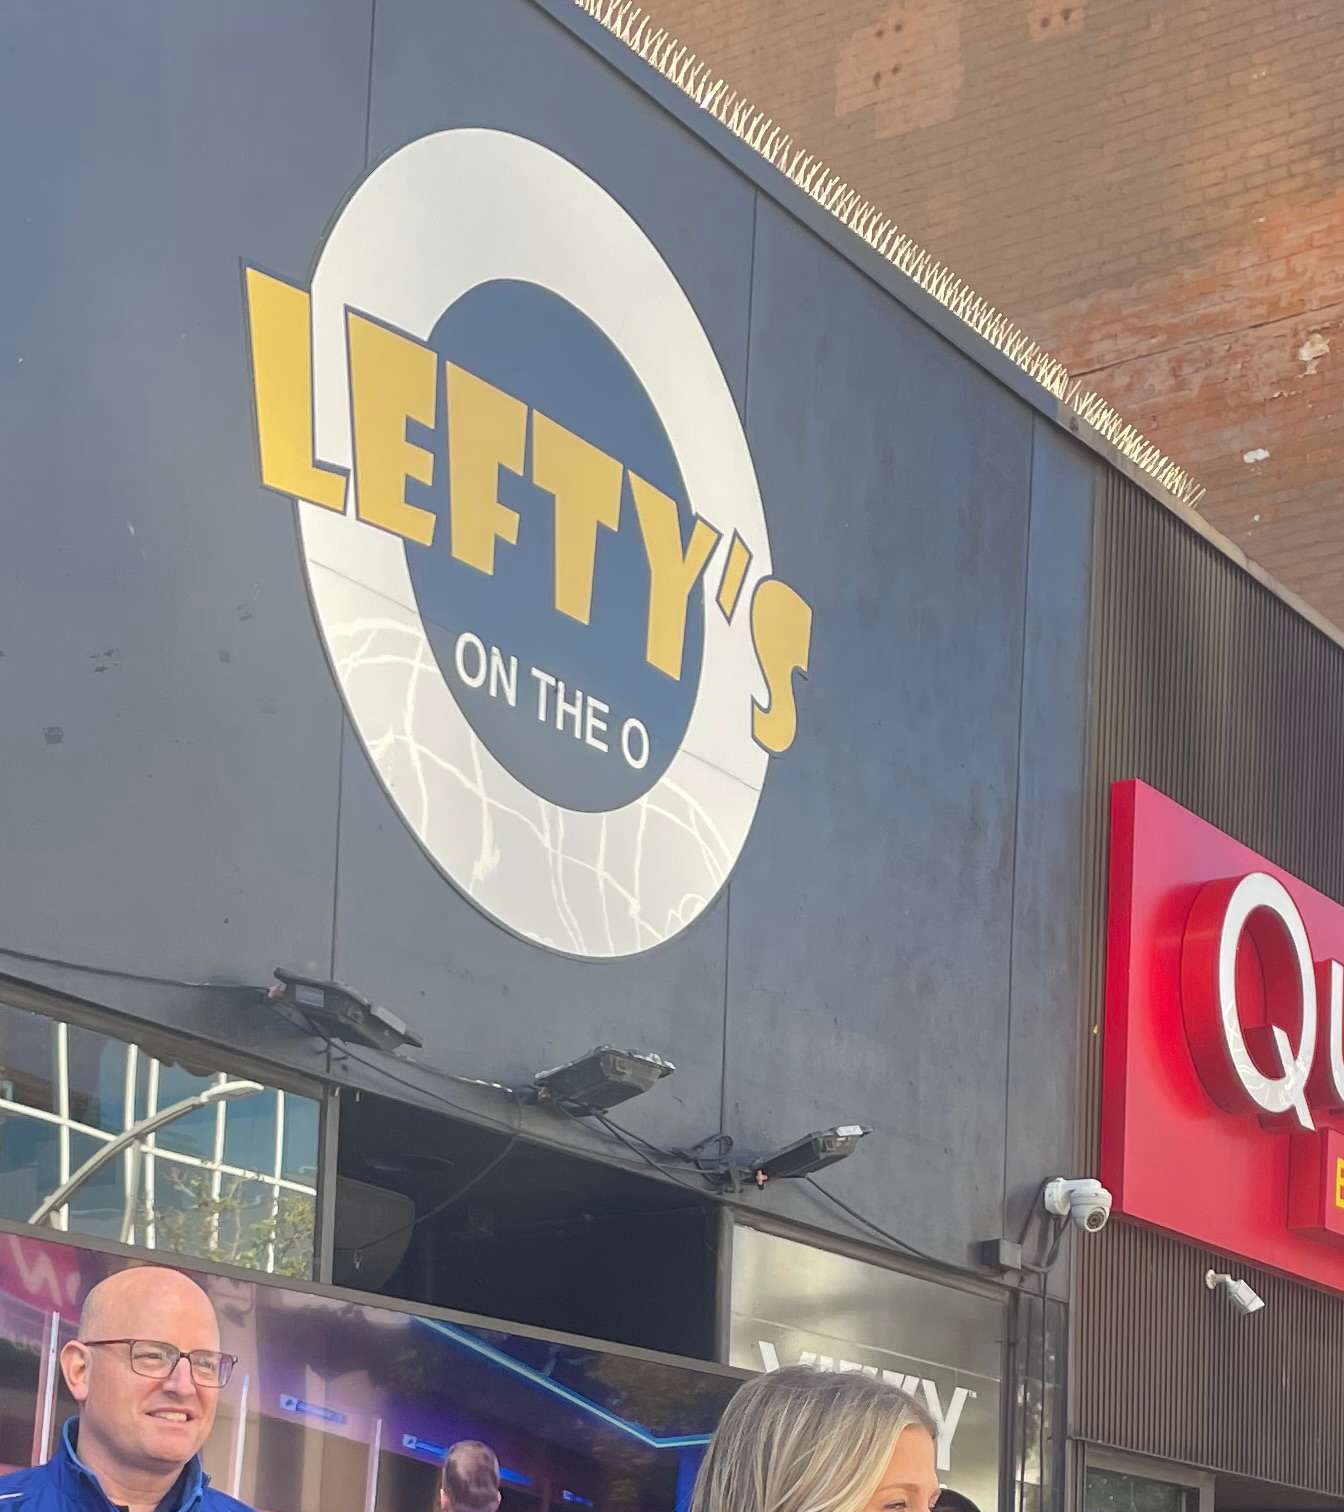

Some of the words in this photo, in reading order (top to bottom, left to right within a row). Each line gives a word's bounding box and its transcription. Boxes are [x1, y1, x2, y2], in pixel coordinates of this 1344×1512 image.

[246, 267, 813, 753] LEFTY'S
[456, 632, 518, 707] ON
[531, 667, 609, 753] THE
[621, 718, 650, 769] O
